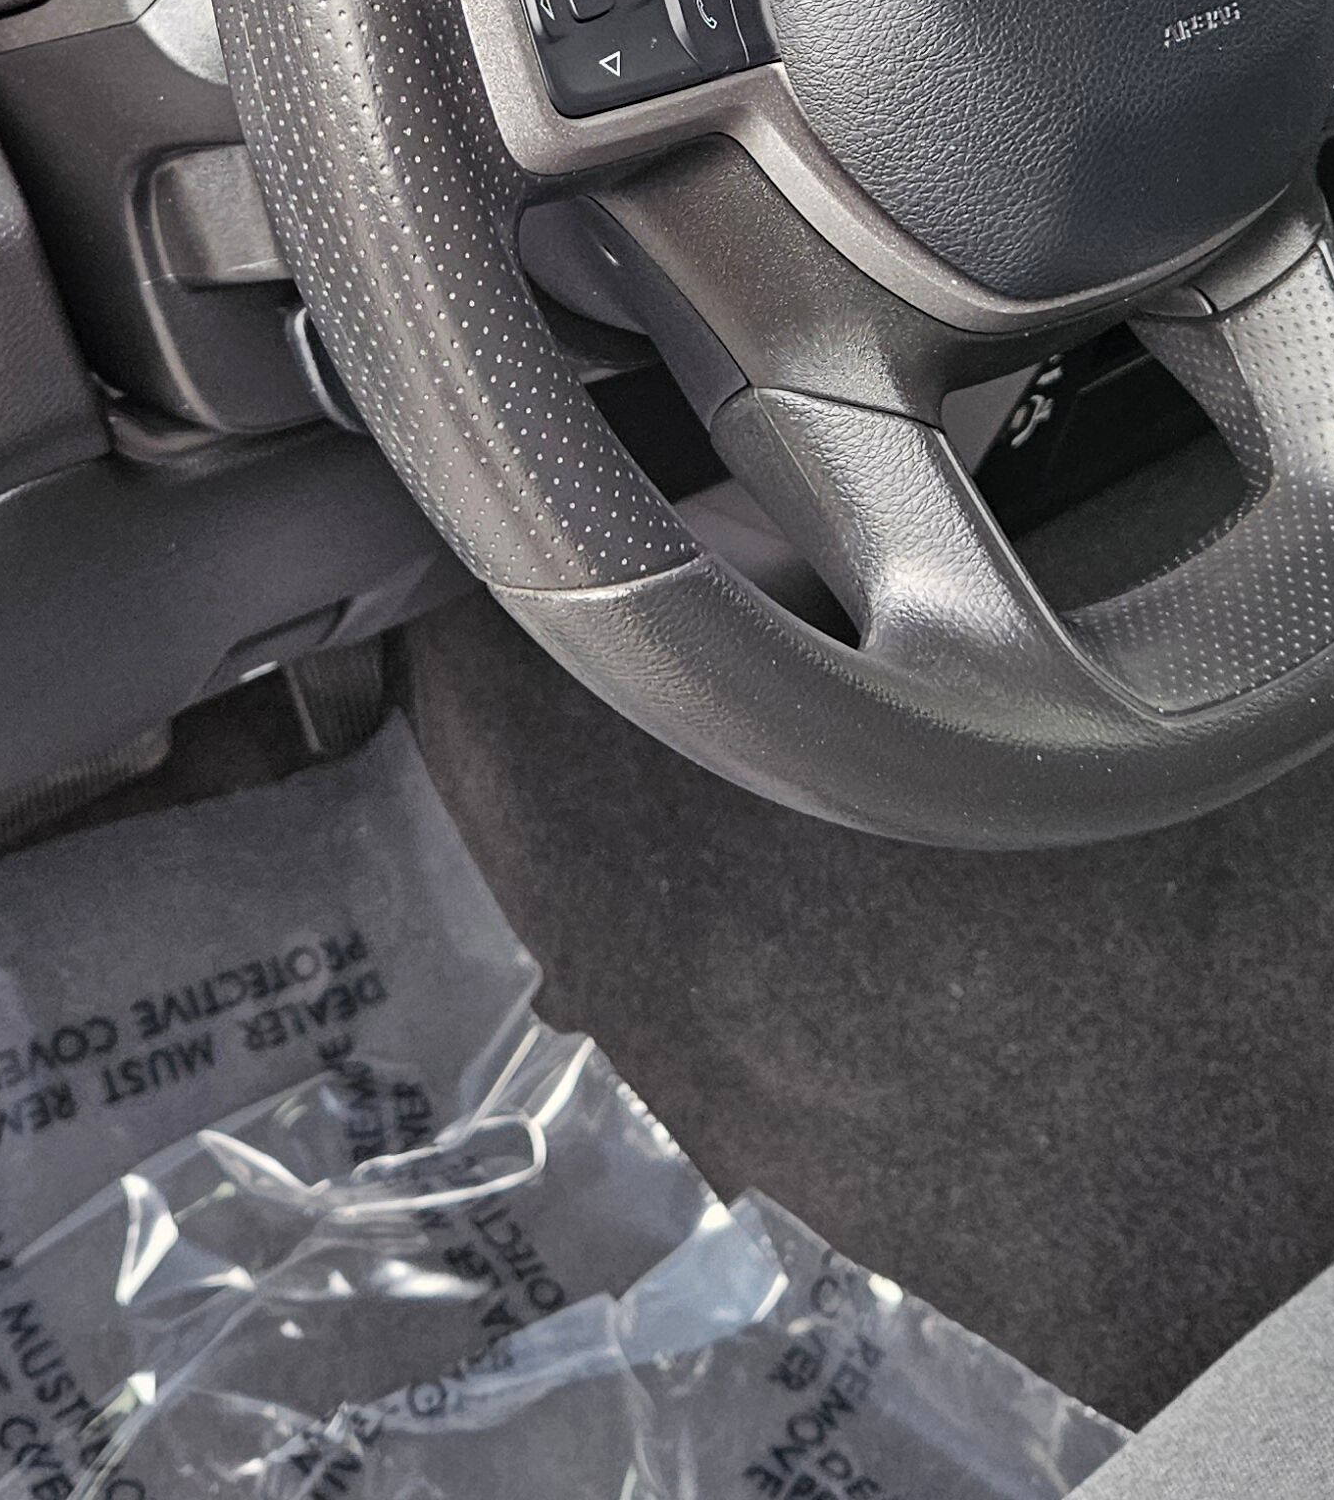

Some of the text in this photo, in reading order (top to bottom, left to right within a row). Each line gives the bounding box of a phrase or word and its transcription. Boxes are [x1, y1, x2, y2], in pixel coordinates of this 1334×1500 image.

[131, 932, 367, 1039] PROTECTIVE
[236, 970, 389, 1052] DEALER
[99, 1033, 216, 1102] MUST
